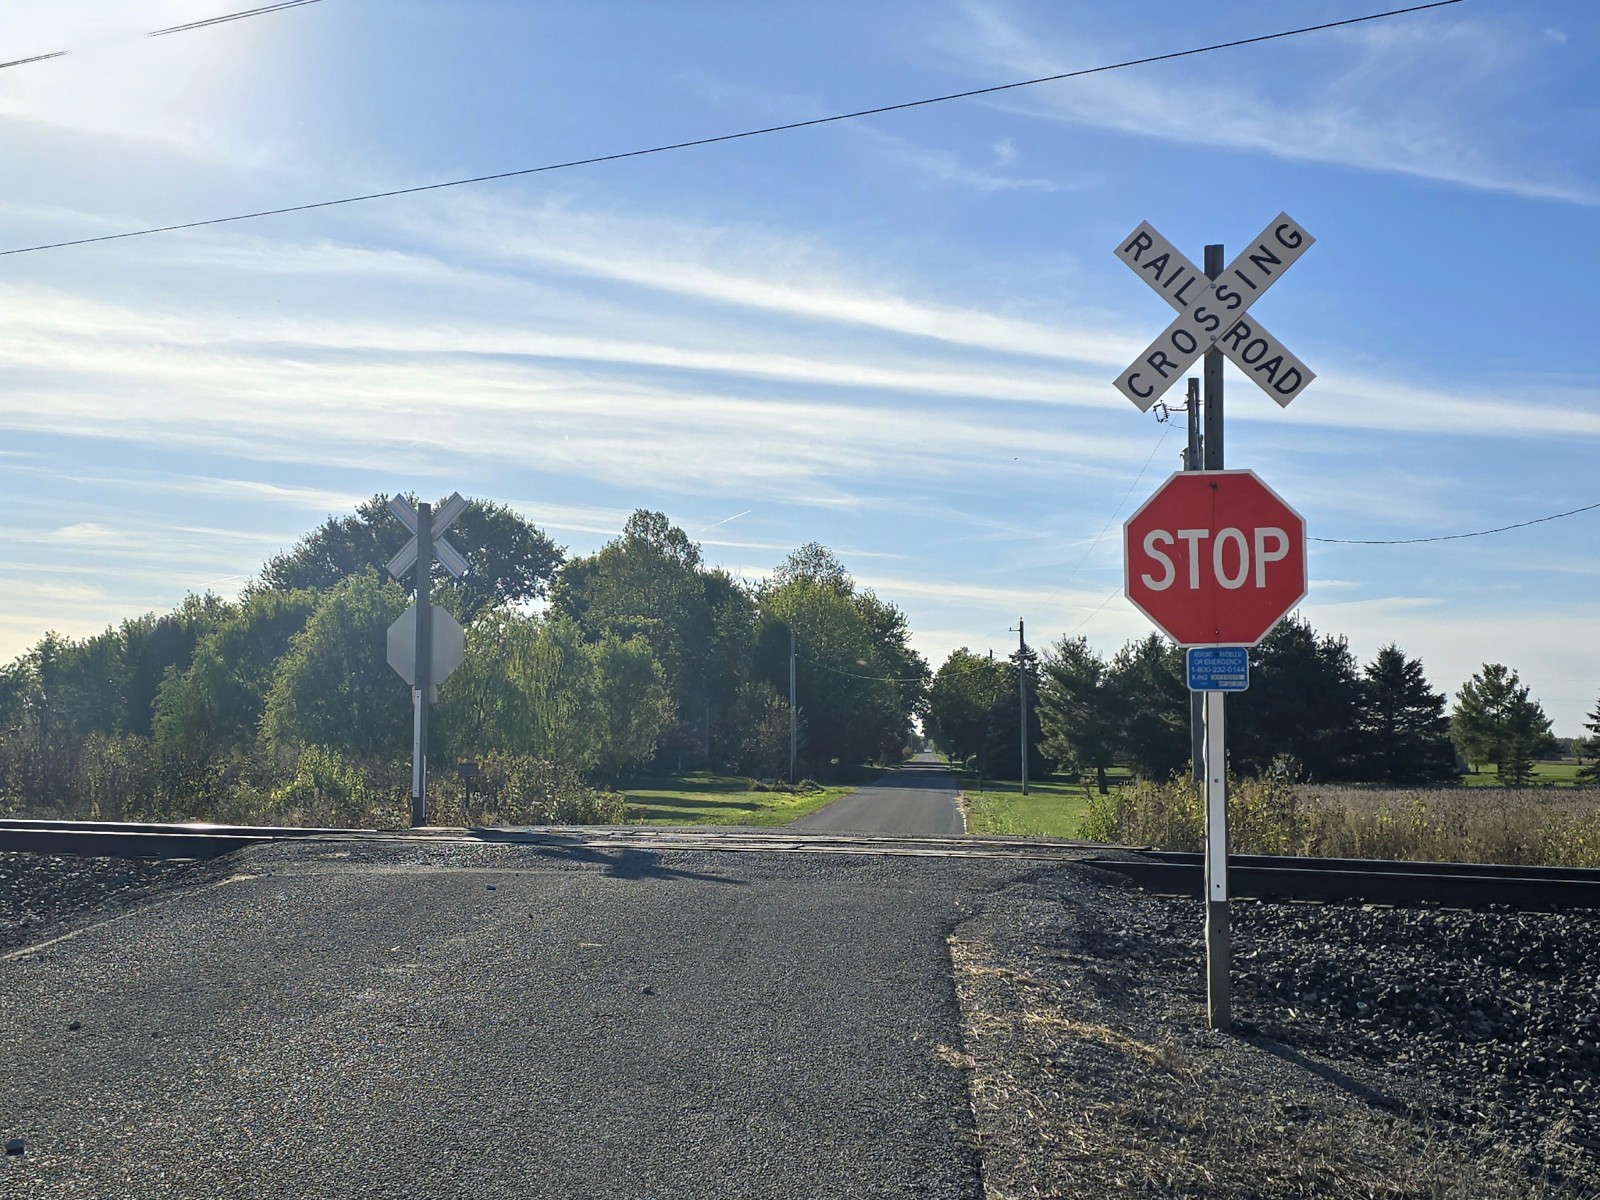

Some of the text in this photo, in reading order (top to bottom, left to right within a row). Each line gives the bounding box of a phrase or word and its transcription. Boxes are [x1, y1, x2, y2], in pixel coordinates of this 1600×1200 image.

[1124, 230, 1303, 395] RAIL ROAD
[1127, 223, 1303, 398] CROSSING
[1141, 527, 1290, 592] STOP
